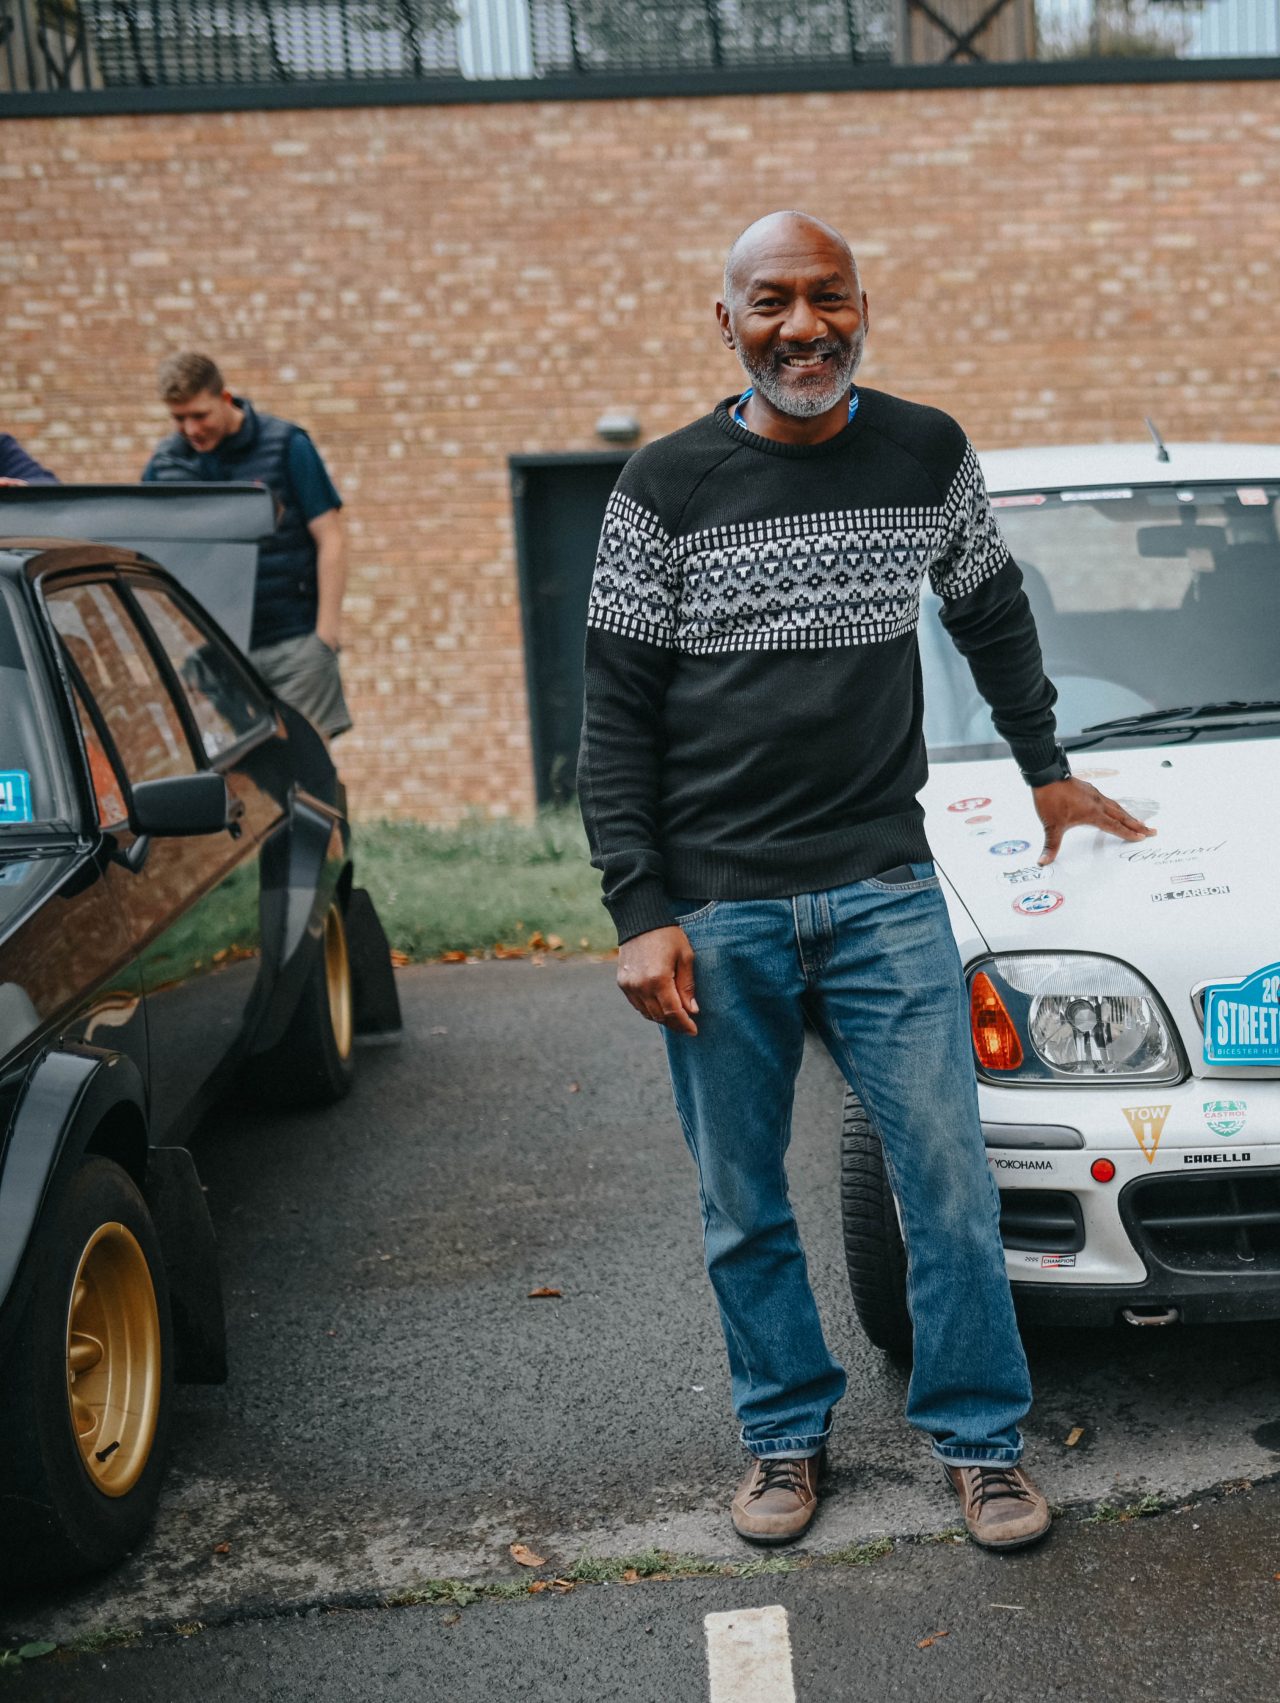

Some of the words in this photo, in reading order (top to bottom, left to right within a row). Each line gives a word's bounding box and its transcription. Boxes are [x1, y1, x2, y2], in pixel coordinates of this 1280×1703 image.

[1151, 893, 1169, 902] DE
[1173, 885, 1230, 899] CARBON
[1217, 1047, 1259, 1055] BICESTER
[1127, 1107, 1167, 1121] TOW
[1204, 1111, 1247, 1119] CASTROL
[1184, 1153, 1251, 1163] CARELLO
[994, 1159, 1053, 1170] YOKOHAMA
[1043, 1257, 1074, 1265] CHAMPION
